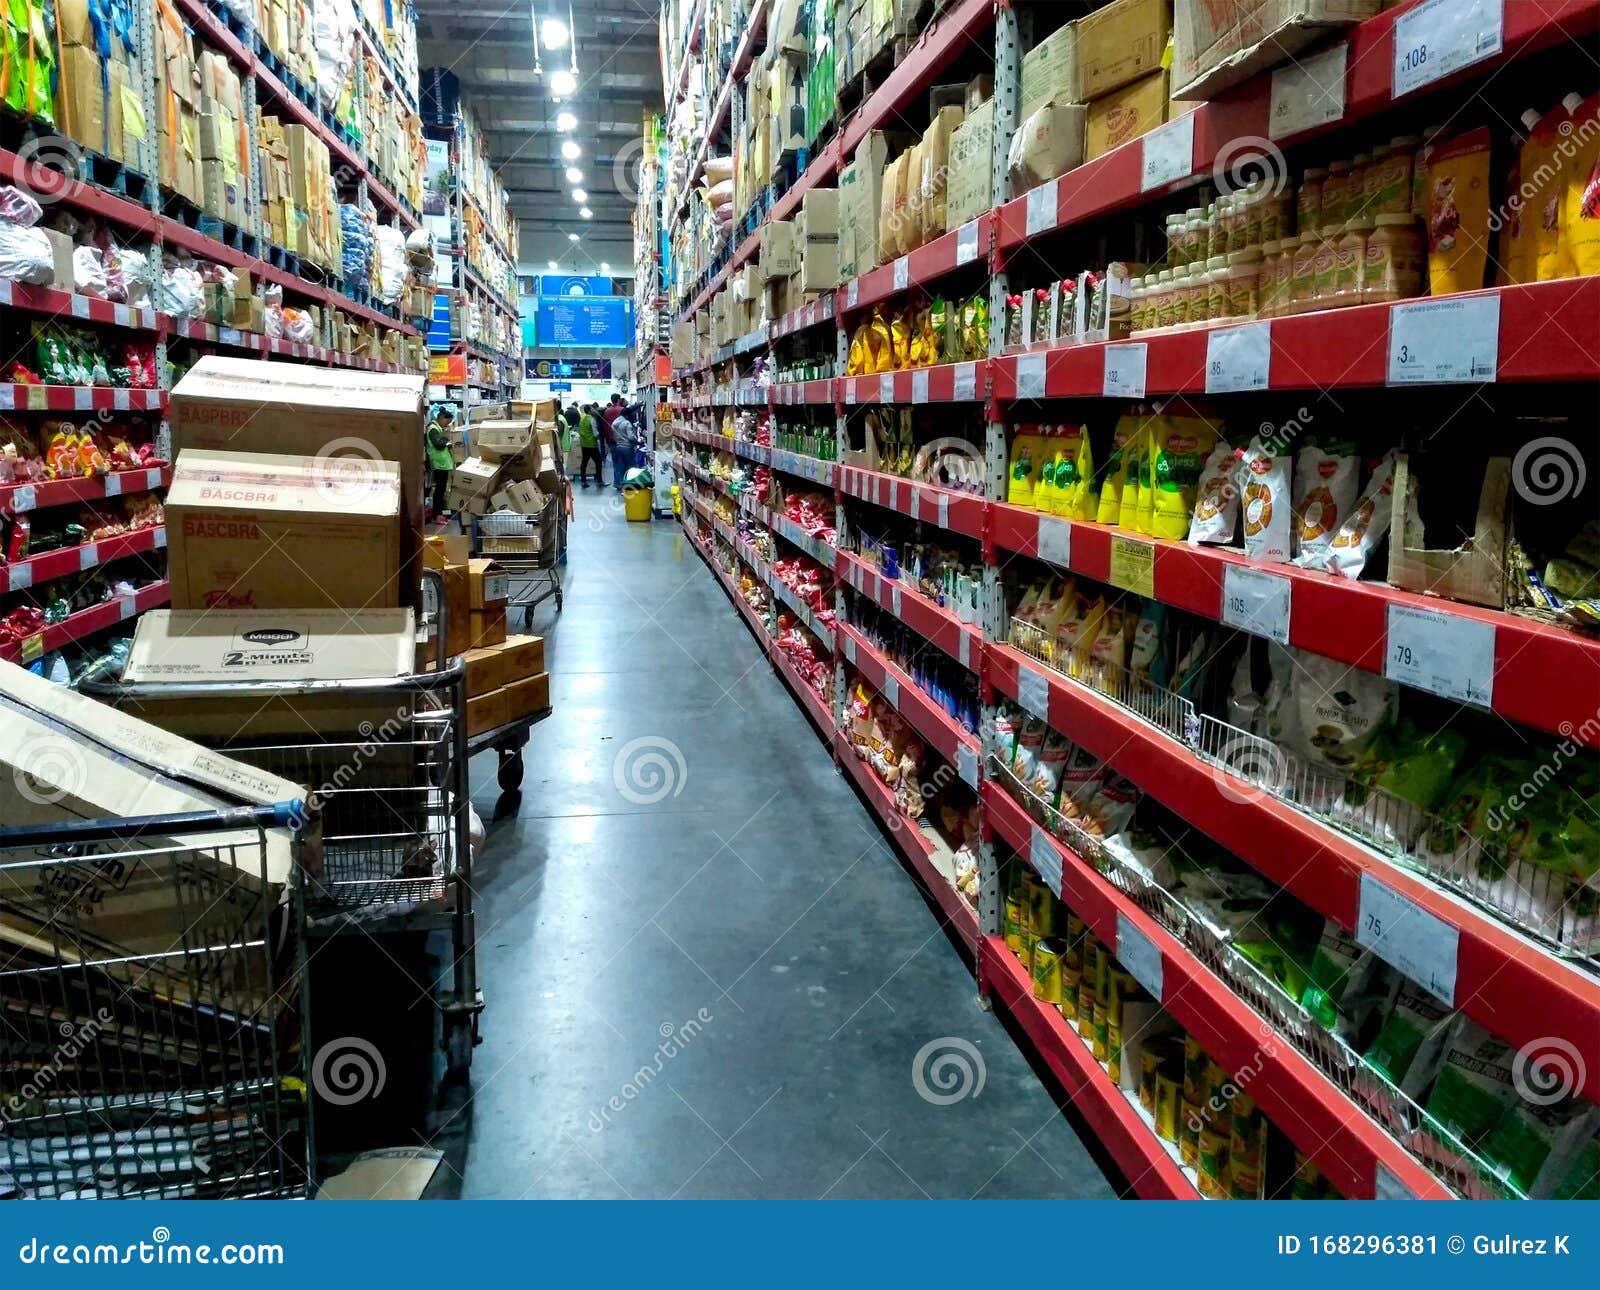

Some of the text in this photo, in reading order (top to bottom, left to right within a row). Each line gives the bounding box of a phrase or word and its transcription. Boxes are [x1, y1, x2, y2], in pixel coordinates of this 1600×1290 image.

[1405, 44, 1427, 71] 108
[1400, 345, 1408, 364] 3
[201, 487, 277, 503] BA5CBR4
[183, 518, 259, 540] BA5CBR4
[1230, 597, 1245, 613] 105
[1397, 645, 1412, 665] 79
[1368, 914, 1381, 937] 75
